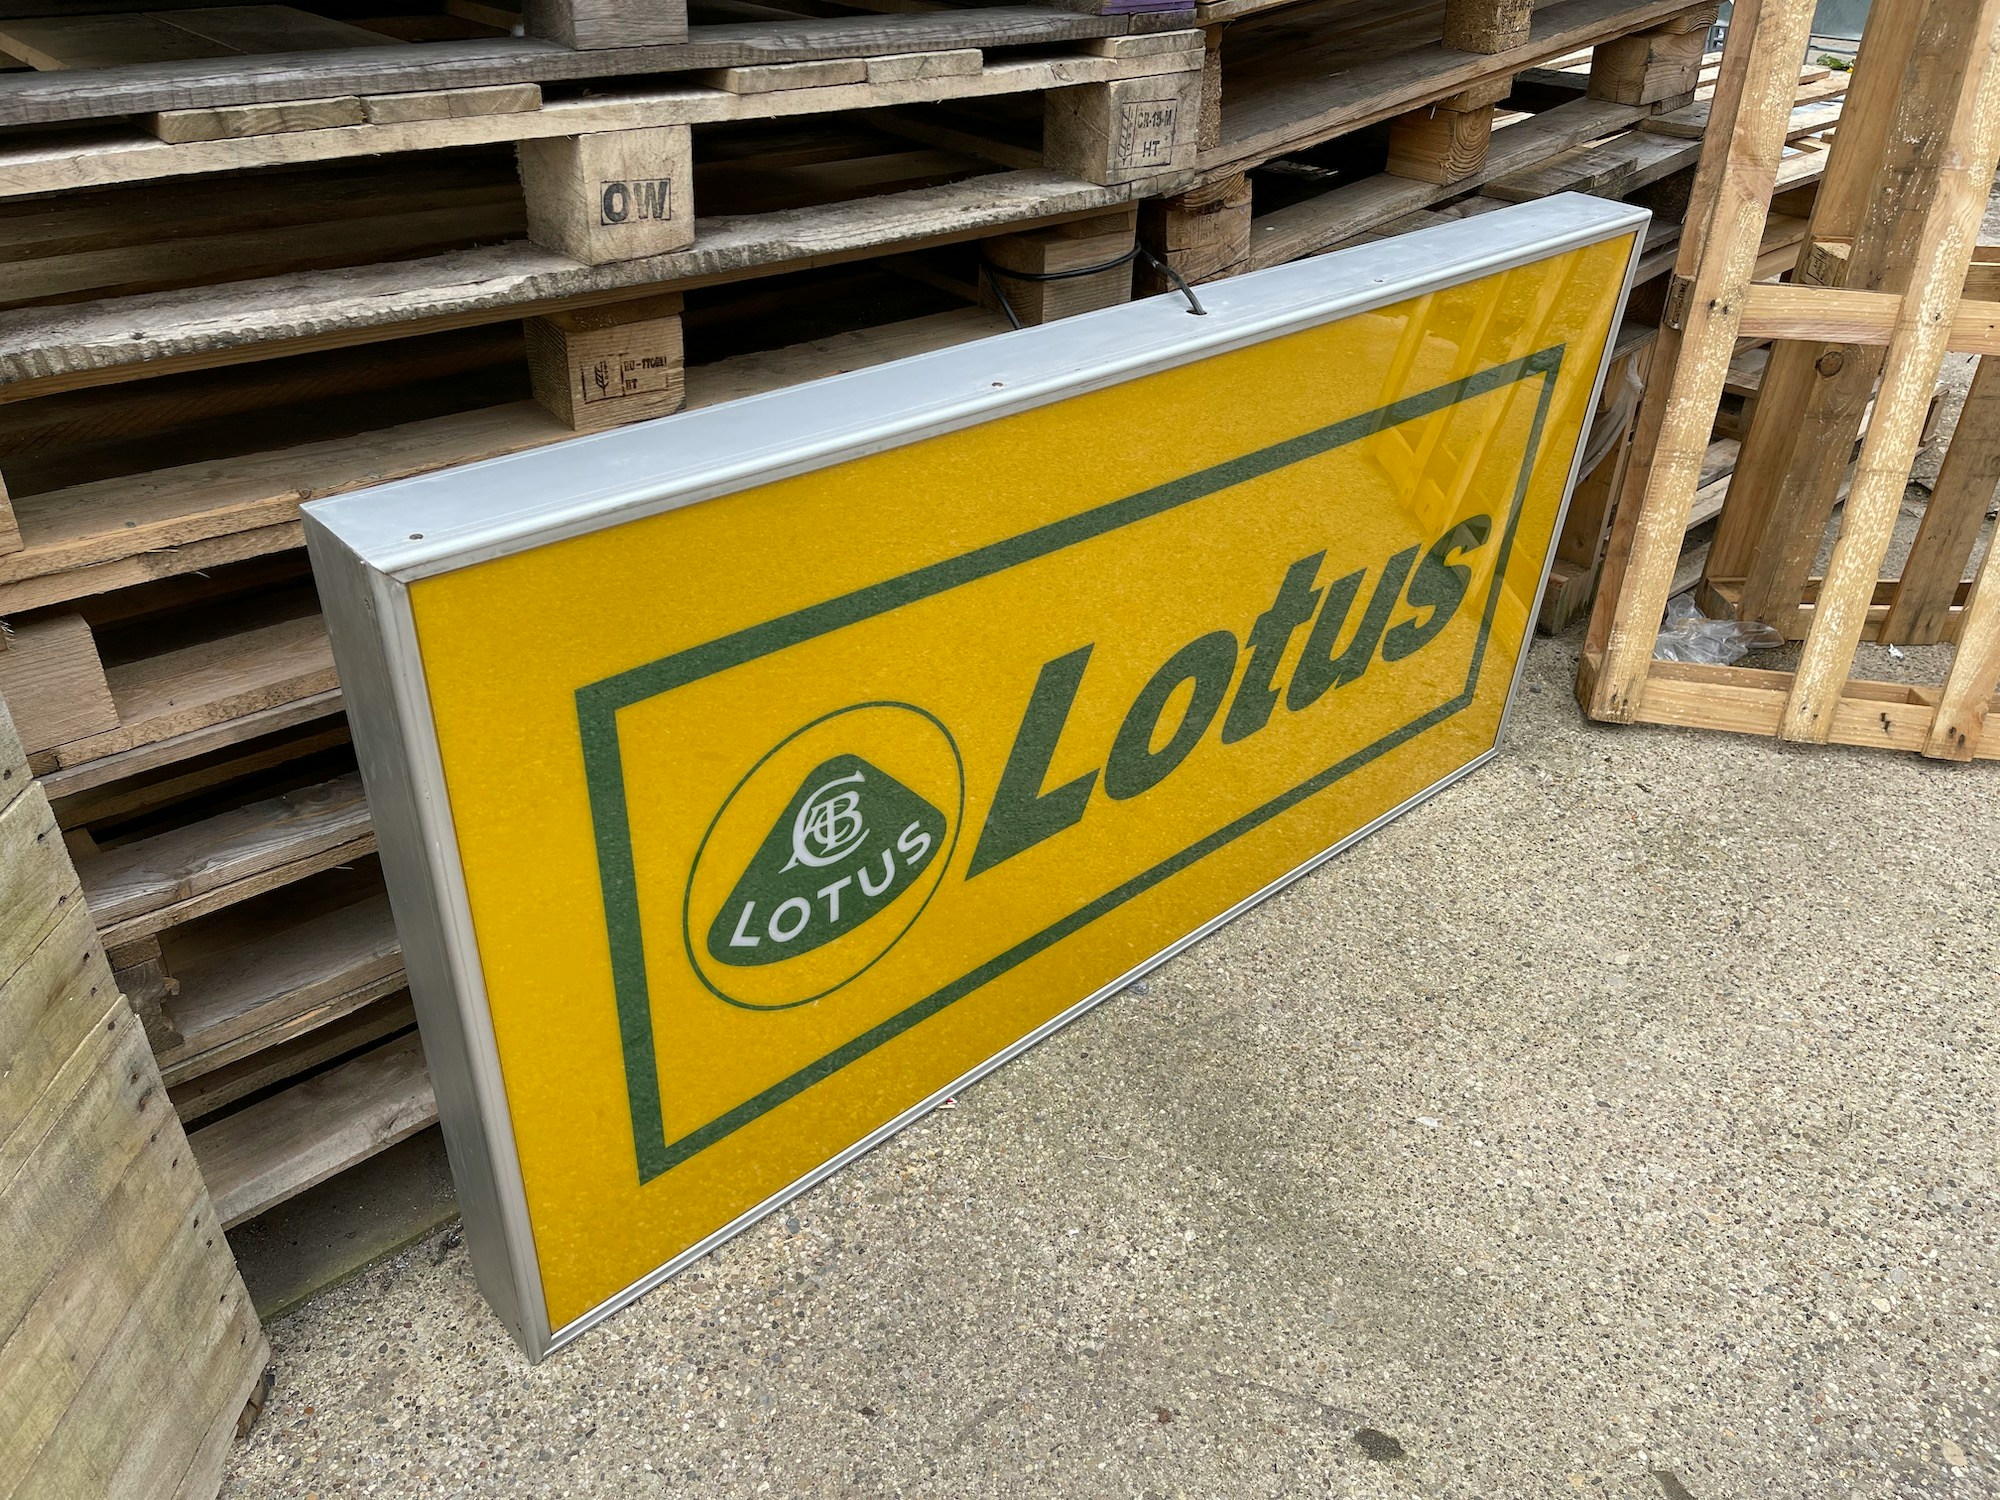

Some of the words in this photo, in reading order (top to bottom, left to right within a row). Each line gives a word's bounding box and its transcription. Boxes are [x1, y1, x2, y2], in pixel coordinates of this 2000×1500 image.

[1142, 140, 1161, 158] HT
[602, 180, 669, 223] OW
[963, 513, 1493, 883] Lotus
[728, 819, 932, 948] LOTUS
